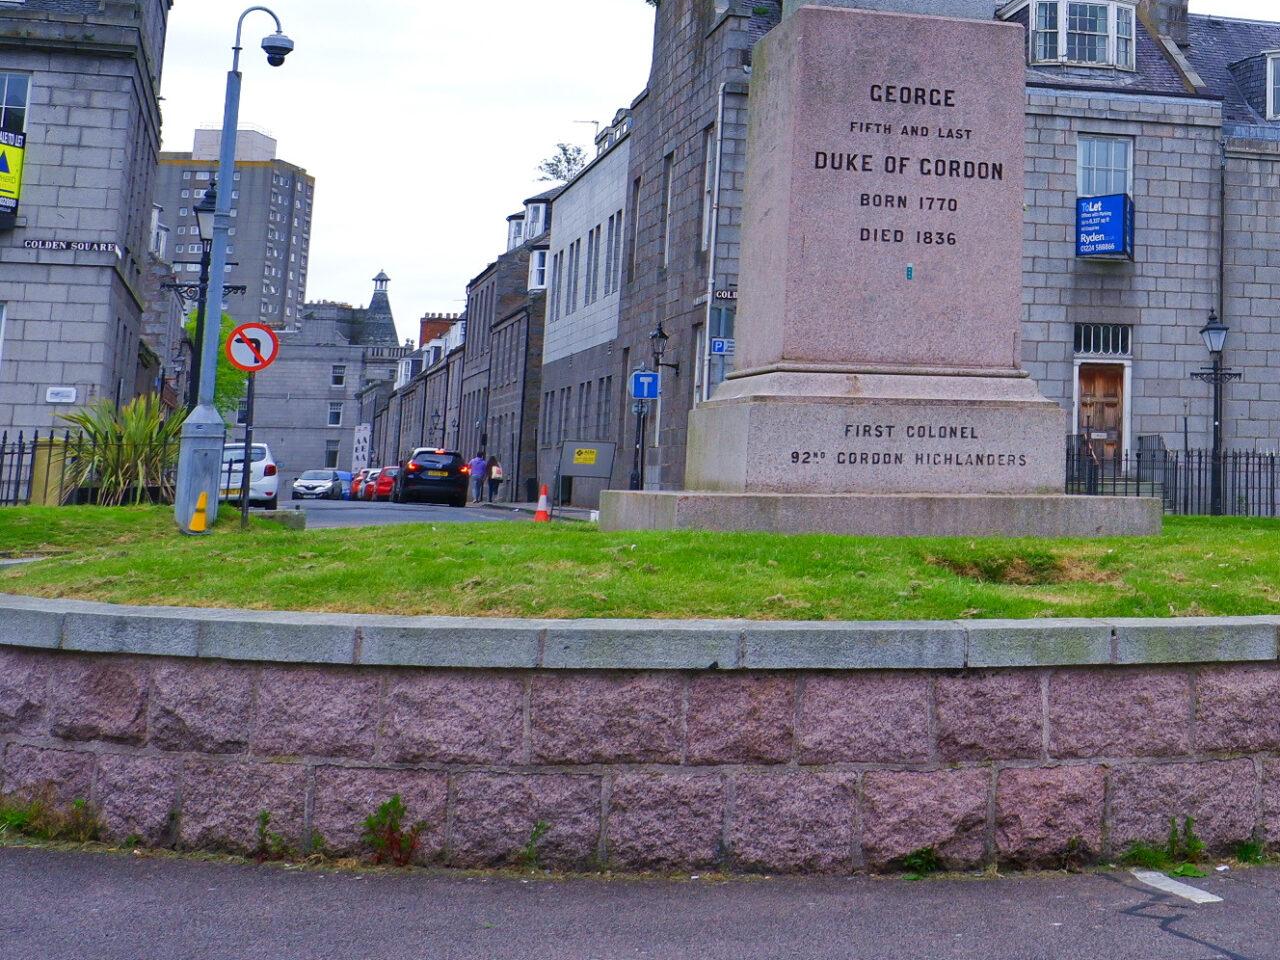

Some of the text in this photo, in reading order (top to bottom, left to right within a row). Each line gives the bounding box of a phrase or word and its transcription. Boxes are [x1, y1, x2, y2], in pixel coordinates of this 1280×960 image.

[870, 84, 956, 107] GEORGE
[850, 121, 972, 140] FIFTH AND LAST
[815, 151, 1003, 180] DUKE OF GORDON
[860, 193, 958, 212] BORN 1770
[860, 228, 956, 246] DIED 1836
[1080, 232, 1105, 244] Ryden
[71, 242, 115, 252] SQUARE
[844, 424, 979, 439] FIRST COLONEL
[837, 452, 904, 465] GORDON
[915, 453, 1027, 466] HIGHLANDERS
